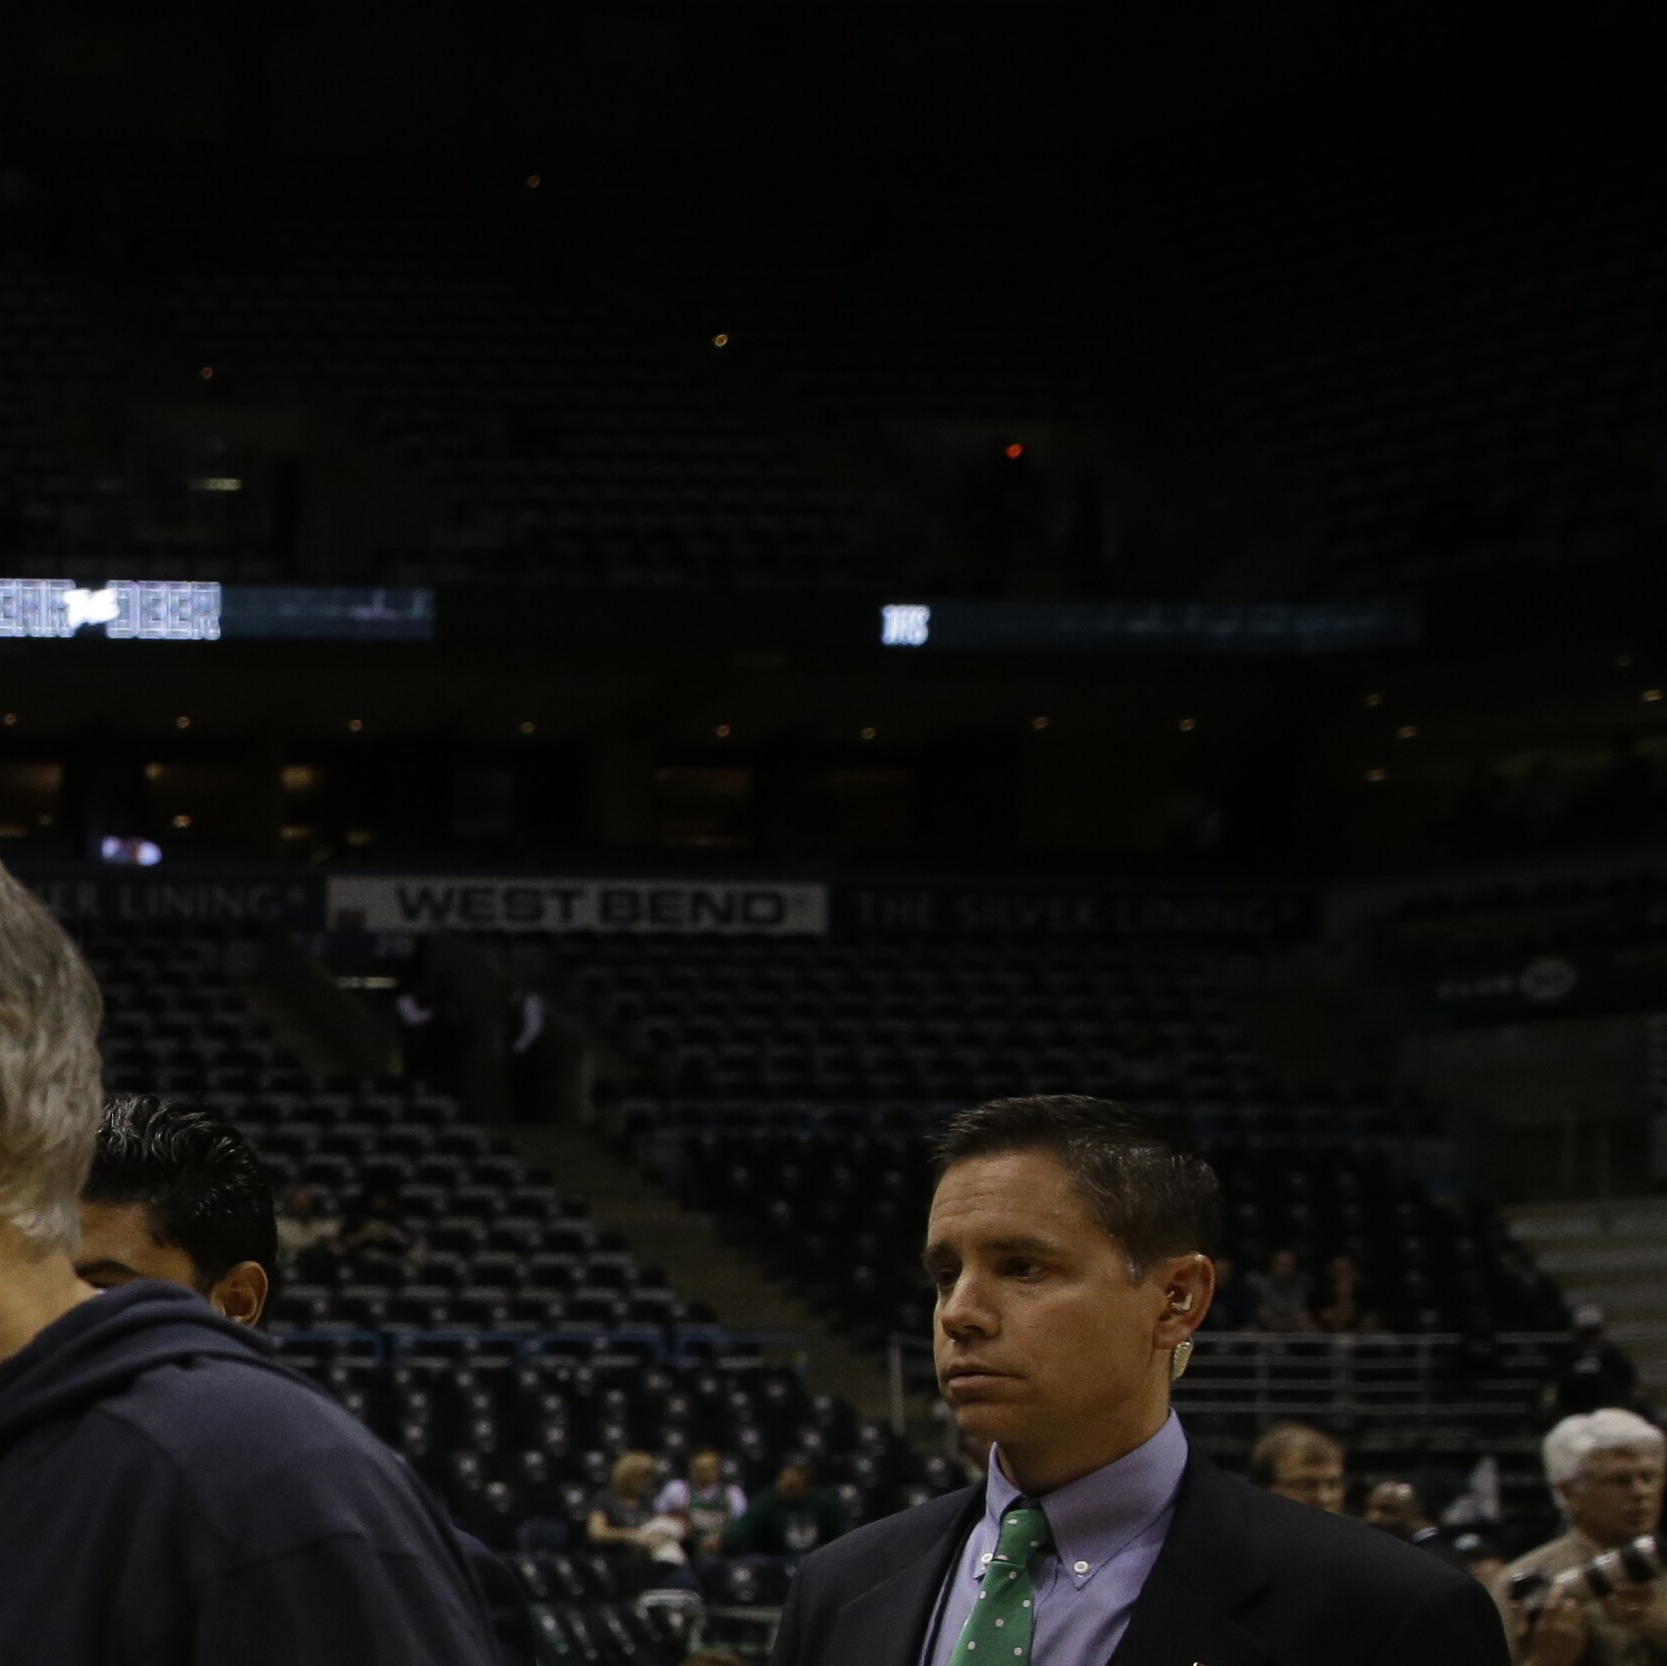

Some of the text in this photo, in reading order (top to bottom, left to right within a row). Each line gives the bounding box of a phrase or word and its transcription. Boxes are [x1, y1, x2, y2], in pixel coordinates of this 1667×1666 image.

[105, 580, 222, 641] DEER
[117, 882, 282, 921] LINING
[394, 885, 787, 926] WEST BEND
